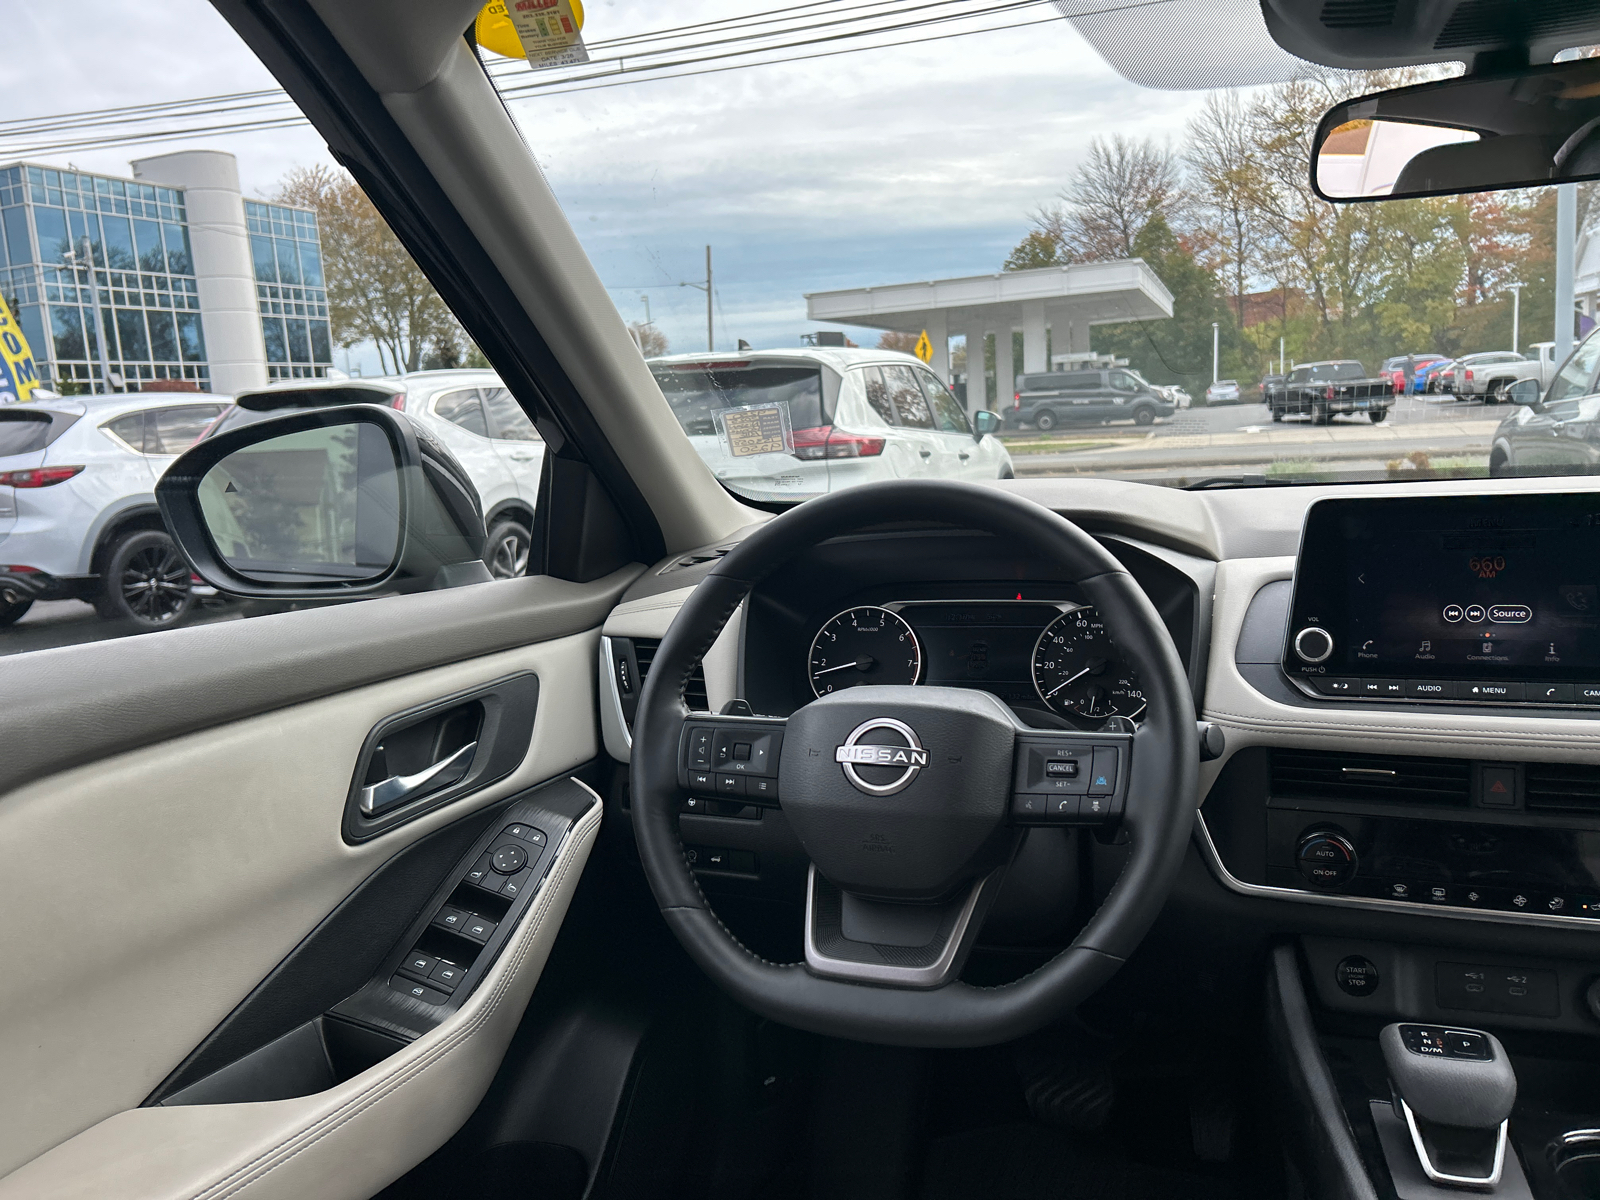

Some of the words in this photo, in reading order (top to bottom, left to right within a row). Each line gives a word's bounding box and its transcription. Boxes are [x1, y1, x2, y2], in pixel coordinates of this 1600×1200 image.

[1469, 556, 1506, 571] 660
[1493, 609, 1527, 618] Source
[880, 619, 885, 627] 5
[1076, 619, 1088, 628] 60
[831, 633, 837, 642] 3
[899, 633, 905, 642] 6
[1052, 636, 1065, 644] 40
[821, 658, 827, 666] 2
[907, 659, 913, 667] 7
[1044, 661, 1055, 669] 20
[827, 684, 833, 692] 0
[1127, 690, 1142, 698] 140
[838, 748, 927, 765] NISSAN
[1057, 749, 1073, 757] RES+
[1048, 764, 1073, 772] CANCEL
[1346, 966, 1366, 974] START
